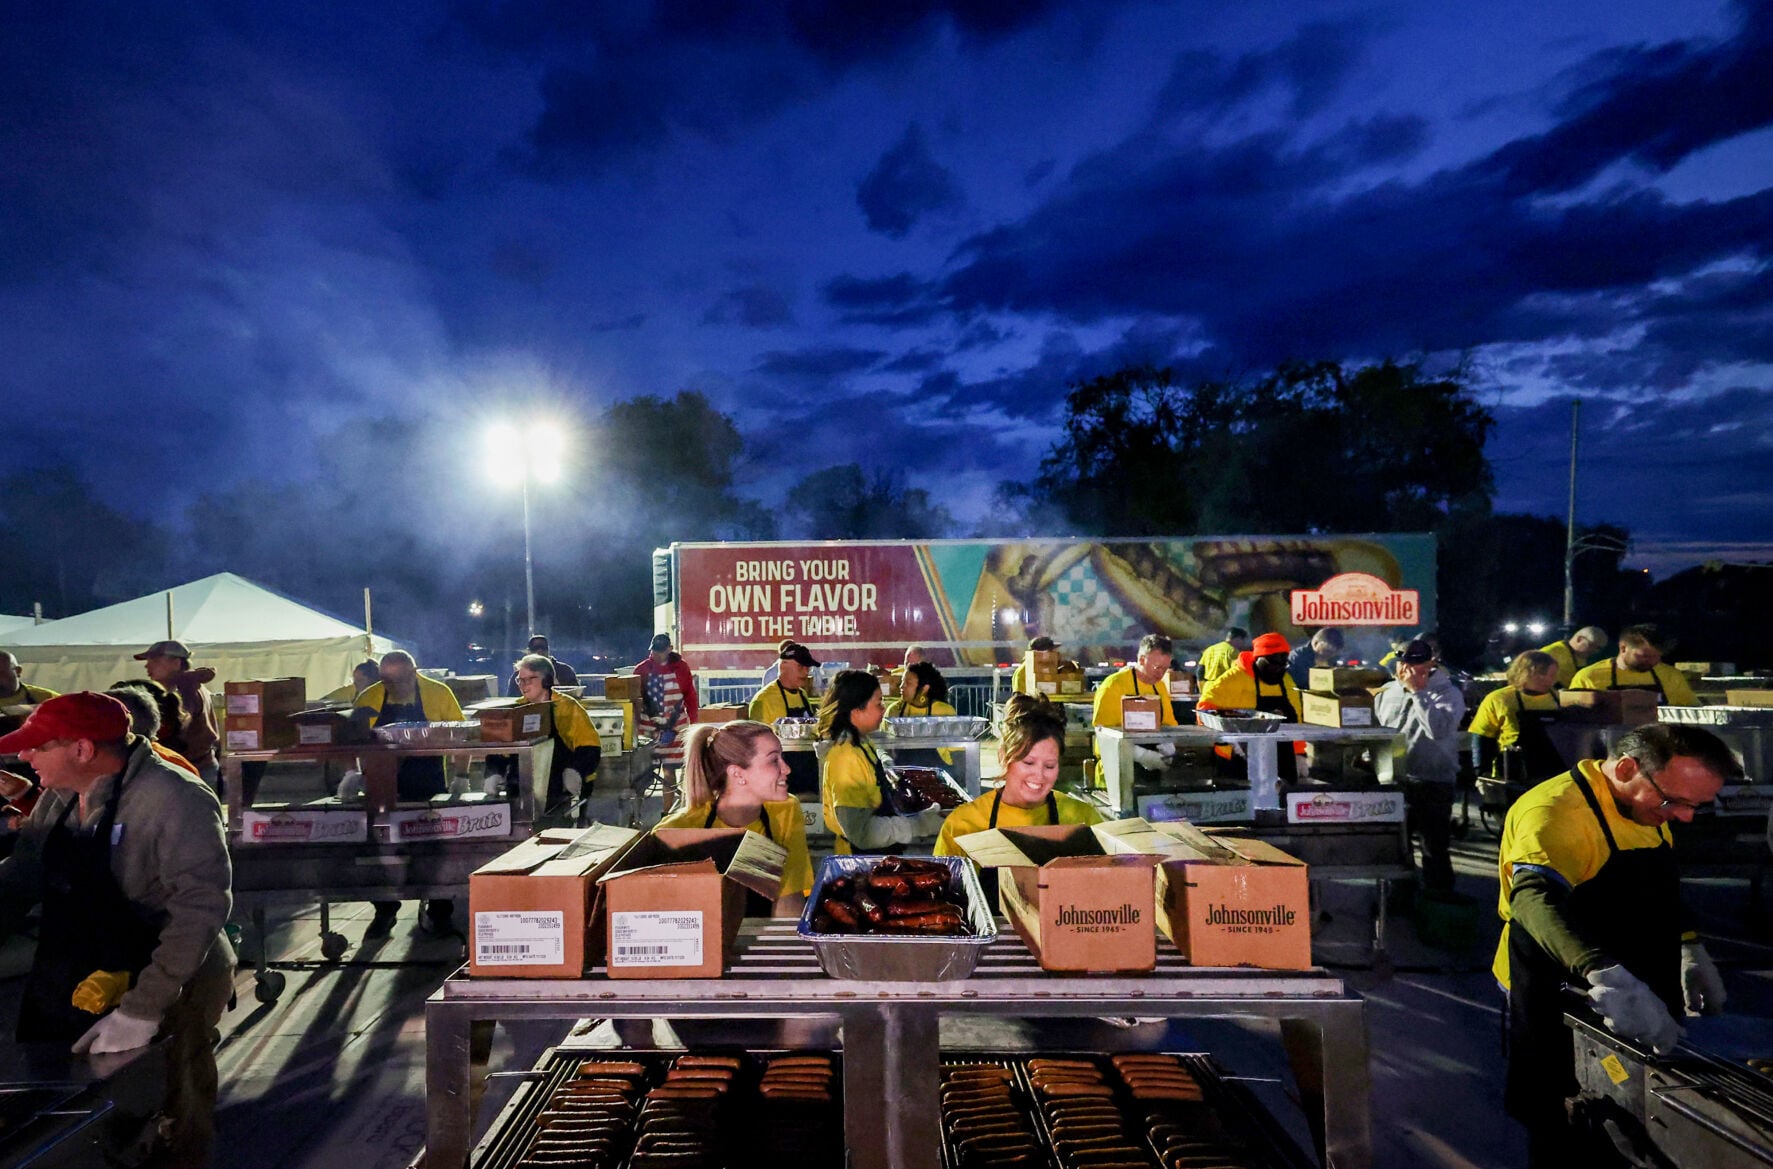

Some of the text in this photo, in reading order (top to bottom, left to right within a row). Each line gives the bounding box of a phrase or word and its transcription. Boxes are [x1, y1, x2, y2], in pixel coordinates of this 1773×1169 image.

[736, 559, 850, 582] BRING YOUR
[709, 583, 878, 613] OWN FLAVOR
[1296, 594, 1413, 622] Johnsonville
[731, 614, 860, 637] TO THE TABLE.
[457, 812, 503, 835] Brats
[1055, 904, 1140, 926] Johnsonville
[1205, 904, 1295, 926] Johnsonville
